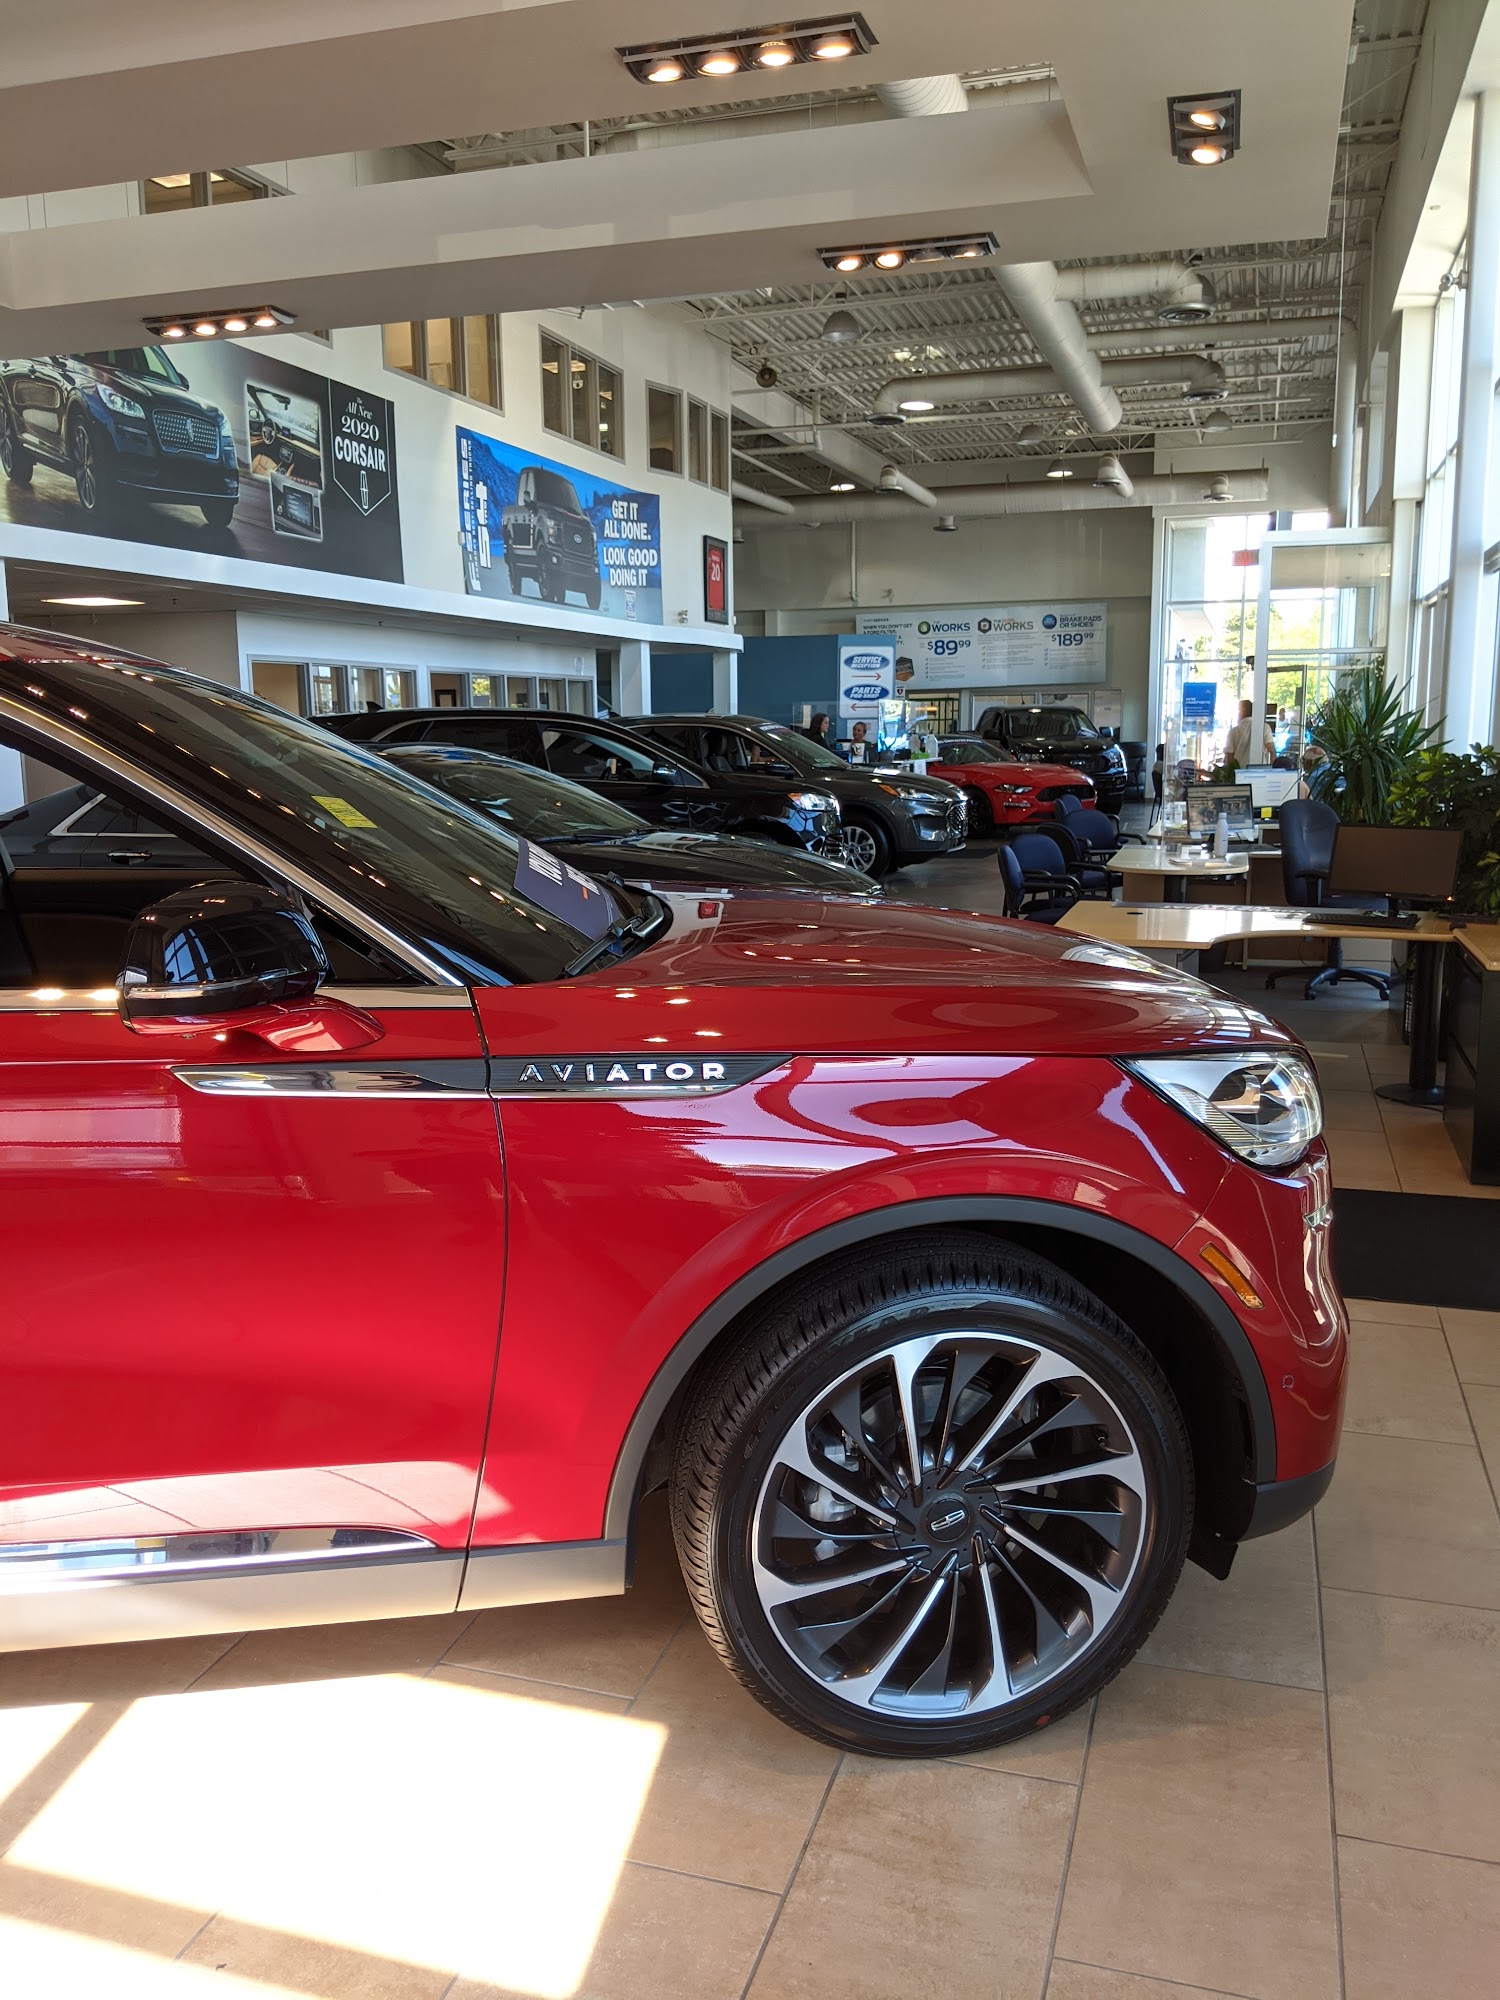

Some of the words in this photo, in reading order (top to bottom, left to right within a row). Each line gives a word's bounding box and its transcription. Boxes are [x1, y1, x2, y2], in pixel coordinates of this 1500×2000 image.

[346, 402, 357, 415] All
[358, 405, 373, 420] New
[341, 415, 380, 442] 2020
[334, 435, 387, 473] CORSAIR
[461, 437, 482, 592] F-SERIES
[611, 500, 628, 519] GET
[629, 502, 639, 521] IT
[475, 481, 492, 569] 54
[604, 519, 620, 538] ALL
[621, 520, 652, 540] DONE.
[603, 546, 627, 566] LOOK
[628, 548, 659, 567] GOOD
[609, 568, 637, 587] DOING
[638, 569, 648, 587] IT
[711, 562, 721, 582] 20
[932, 623, 971, 633] WORKS
[993, 621, 1034, 632] WORKS
[852, 656, 882, 664] SERVICE
[851, 686, 882, 694] PARTS
[518, 1062, 726, 1083] AVIATOR
